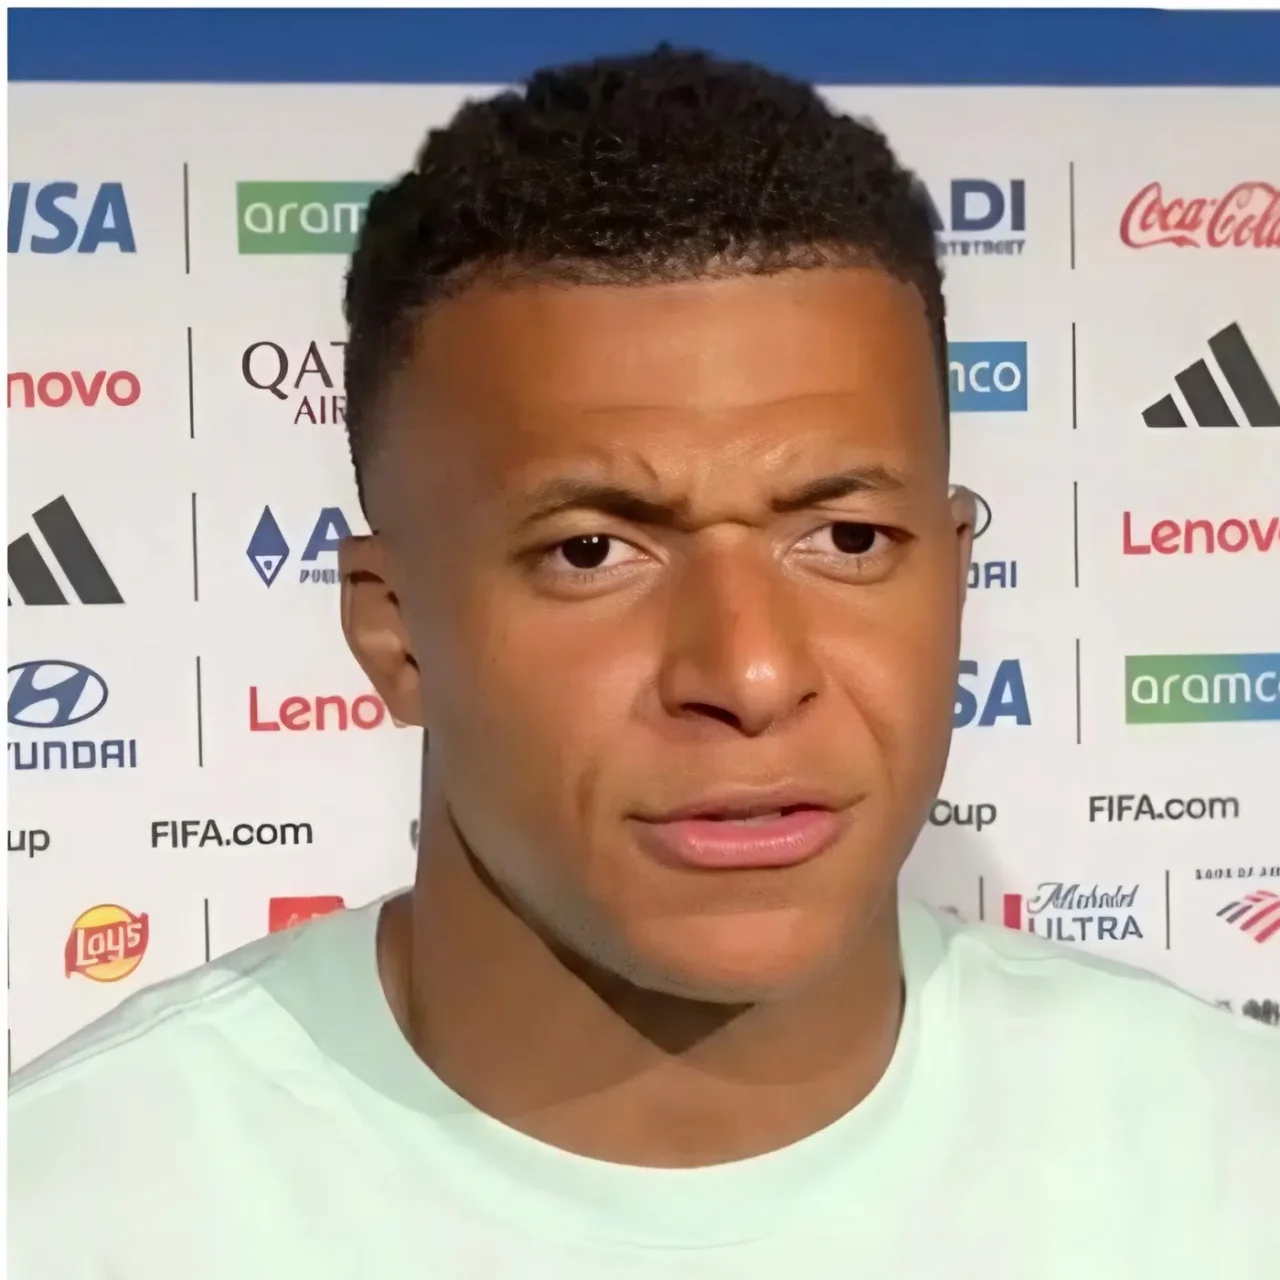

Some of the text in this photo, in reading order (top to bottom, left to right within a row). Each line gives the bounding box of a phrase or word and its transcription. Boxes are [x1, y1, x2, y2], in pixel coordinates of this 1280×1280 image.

[8, 371, 141, 408] novo
[1089, 795, 1239, 822] FIFA.com
[151, 820, 312, 848] FIFA.com
